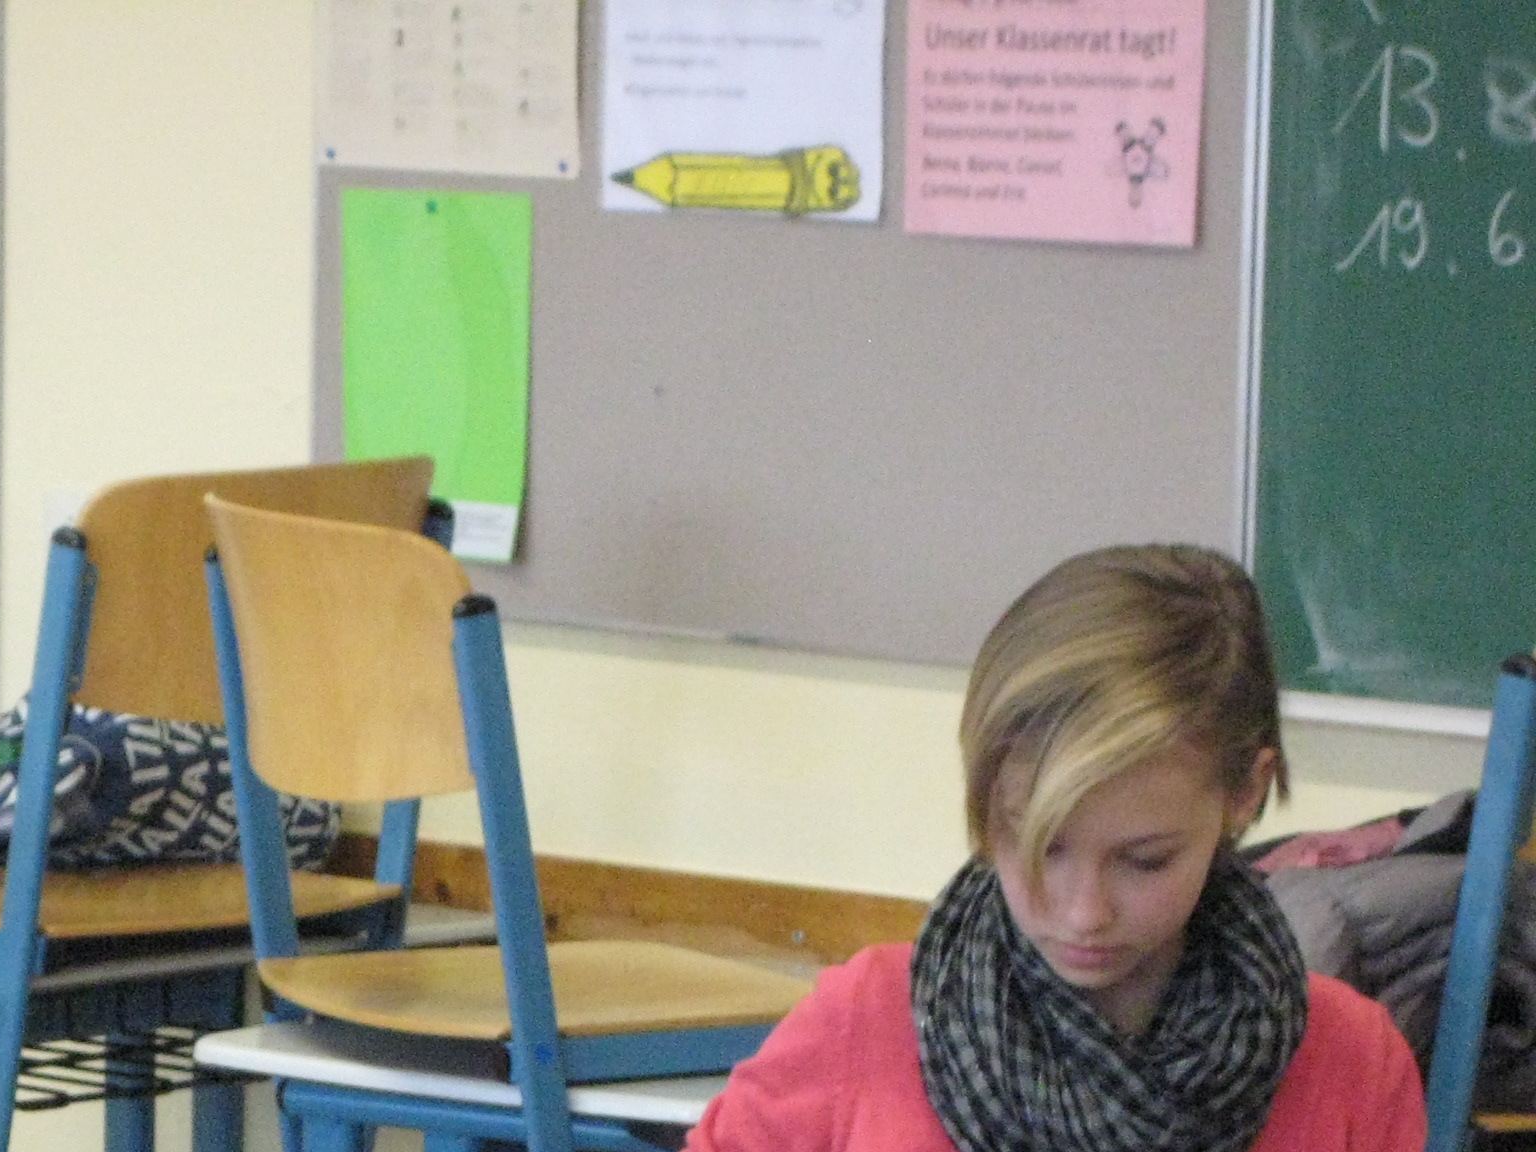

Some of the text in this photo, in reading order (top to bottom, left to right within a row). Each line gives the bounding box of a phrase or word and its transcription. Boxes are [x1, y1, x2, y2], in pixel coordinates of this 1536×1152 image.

[925, 24, 1176, 59] Unser Klassenrat tagt!
